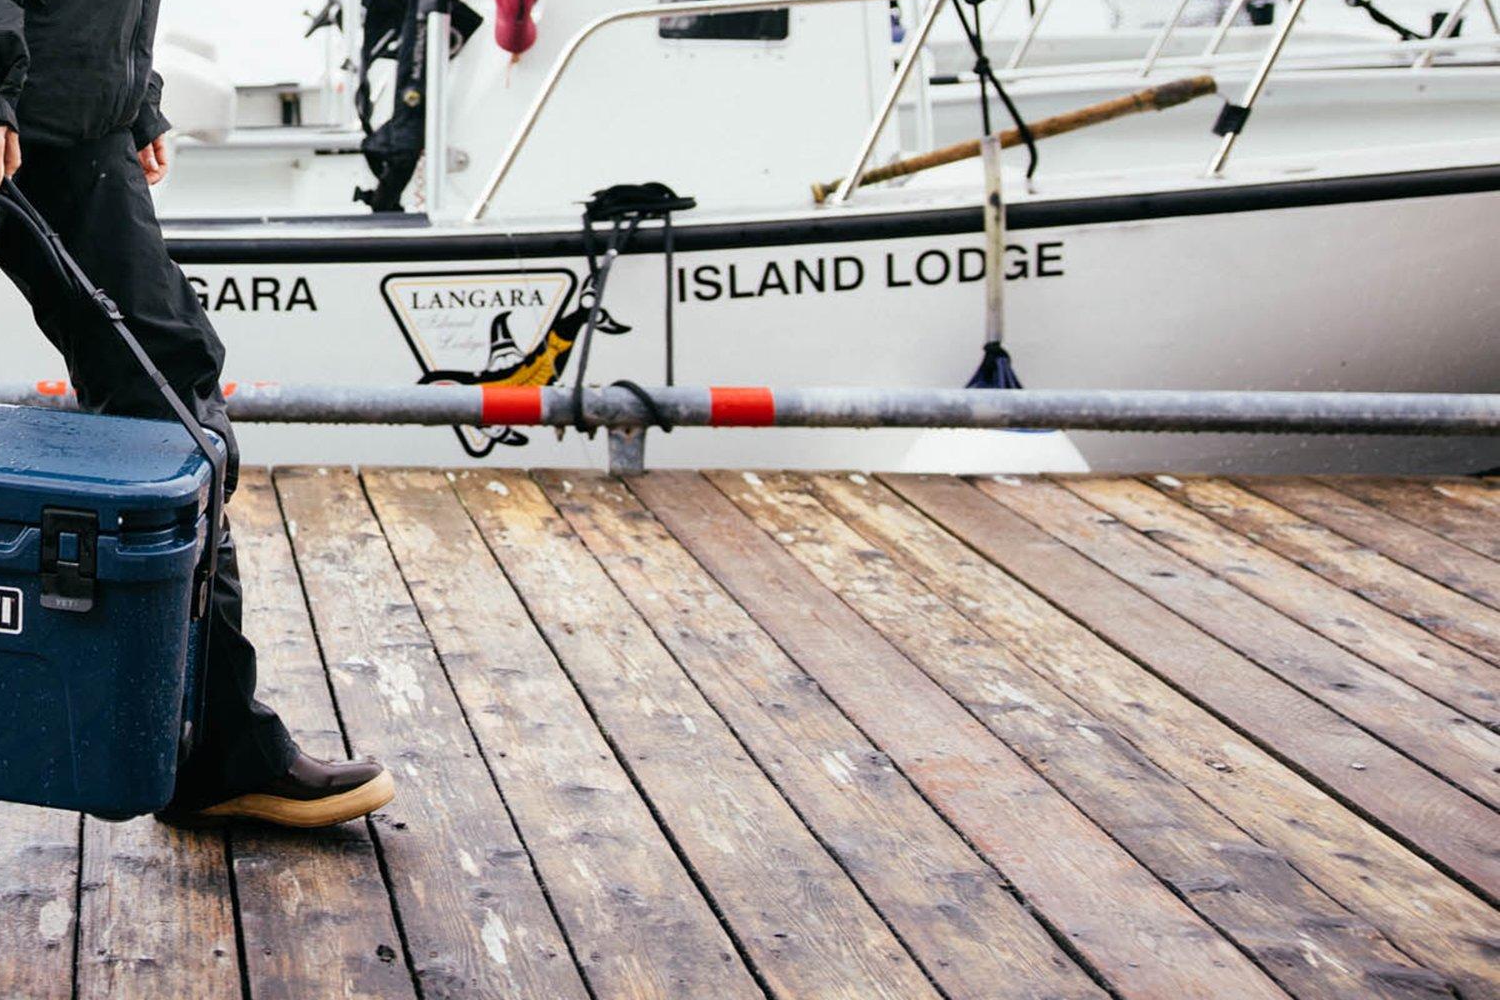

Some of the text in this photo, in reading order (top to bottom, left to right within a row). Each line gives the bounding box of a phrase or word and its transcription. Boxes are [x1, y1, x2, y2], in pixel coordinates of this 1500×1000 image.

[186, 241, 1064, 311] GARA ISLAND LODGE
[412, 289, 545, 309] LANGARA
